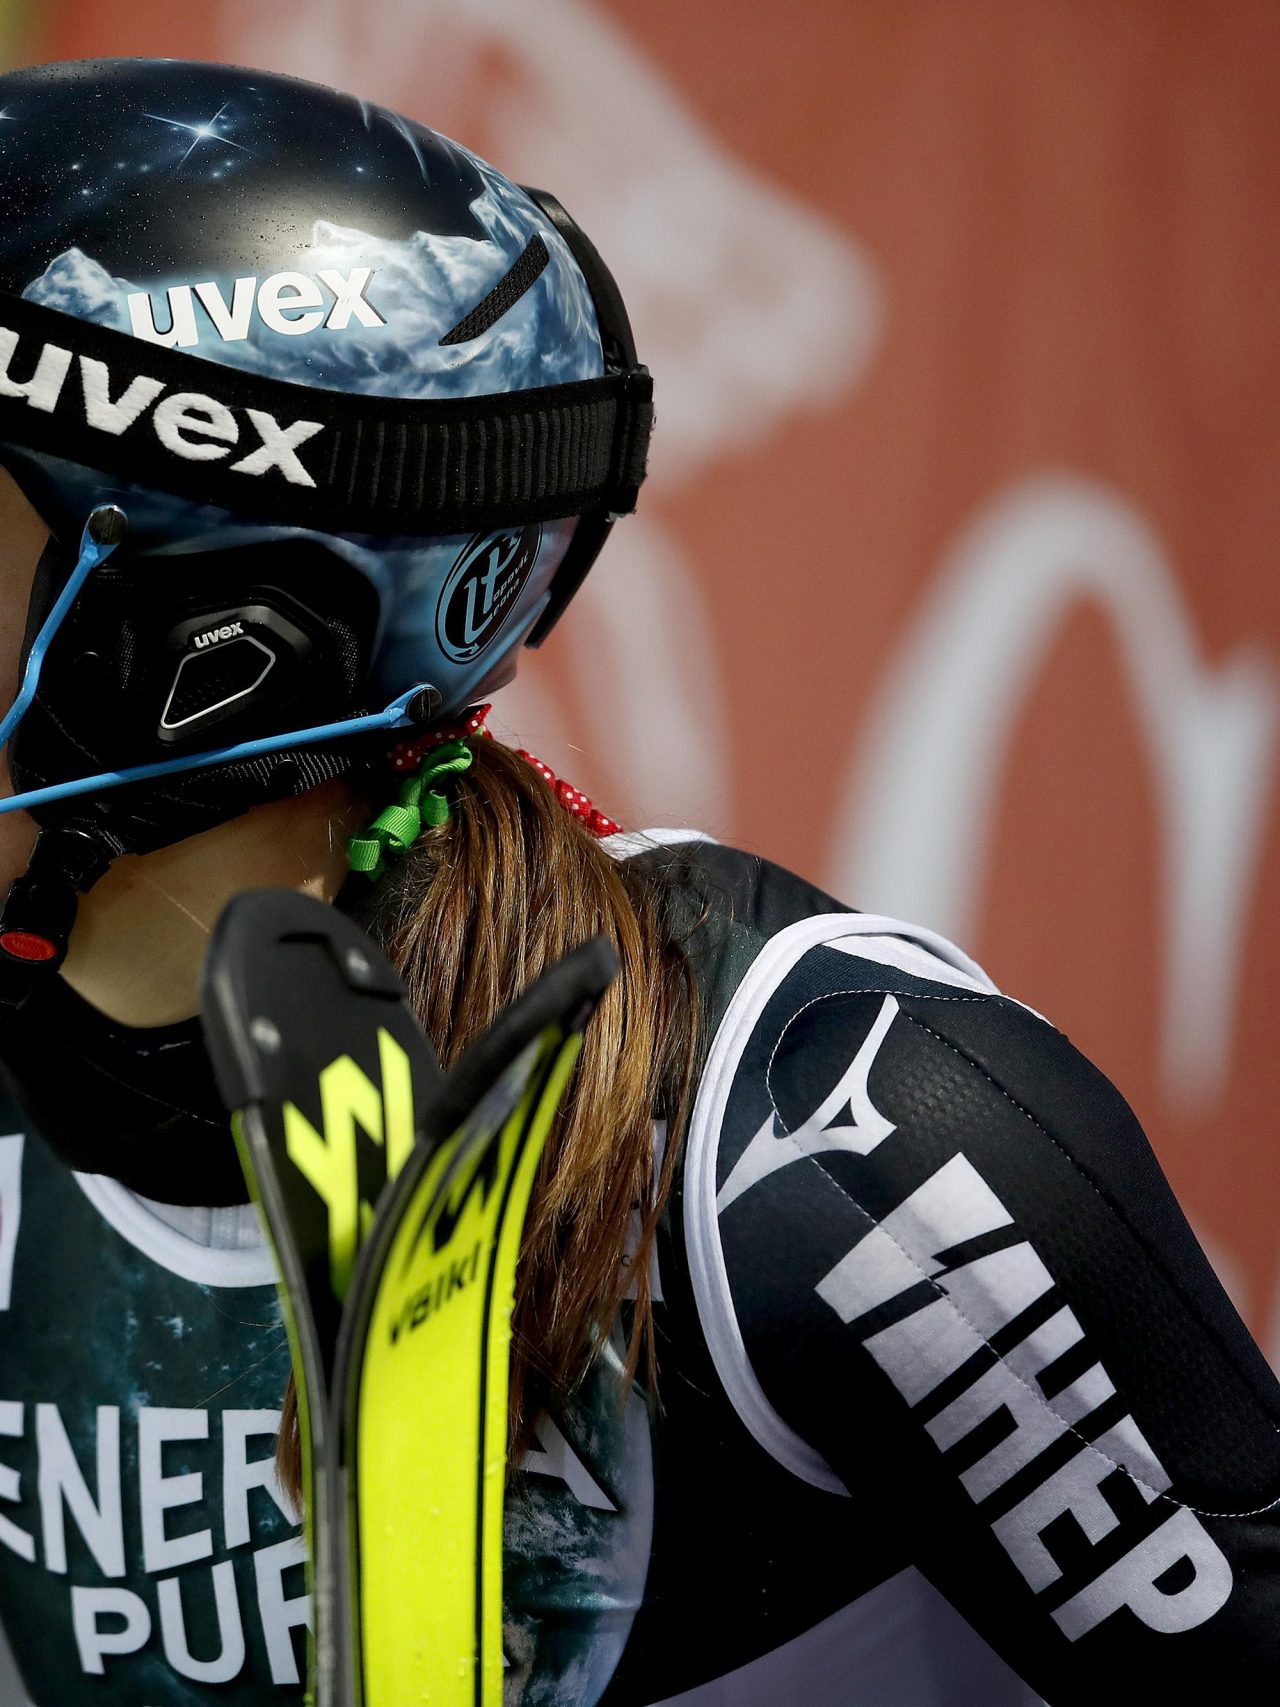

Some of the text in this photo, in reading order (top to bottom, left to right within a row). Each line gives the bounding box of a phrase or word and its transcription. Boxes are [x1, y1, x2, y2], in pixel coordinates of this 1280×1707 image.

[127, 267, 387, 349] uvex
[193, 621, 244, 649] uvex
[70, 1534, 317, 1685] PUR
